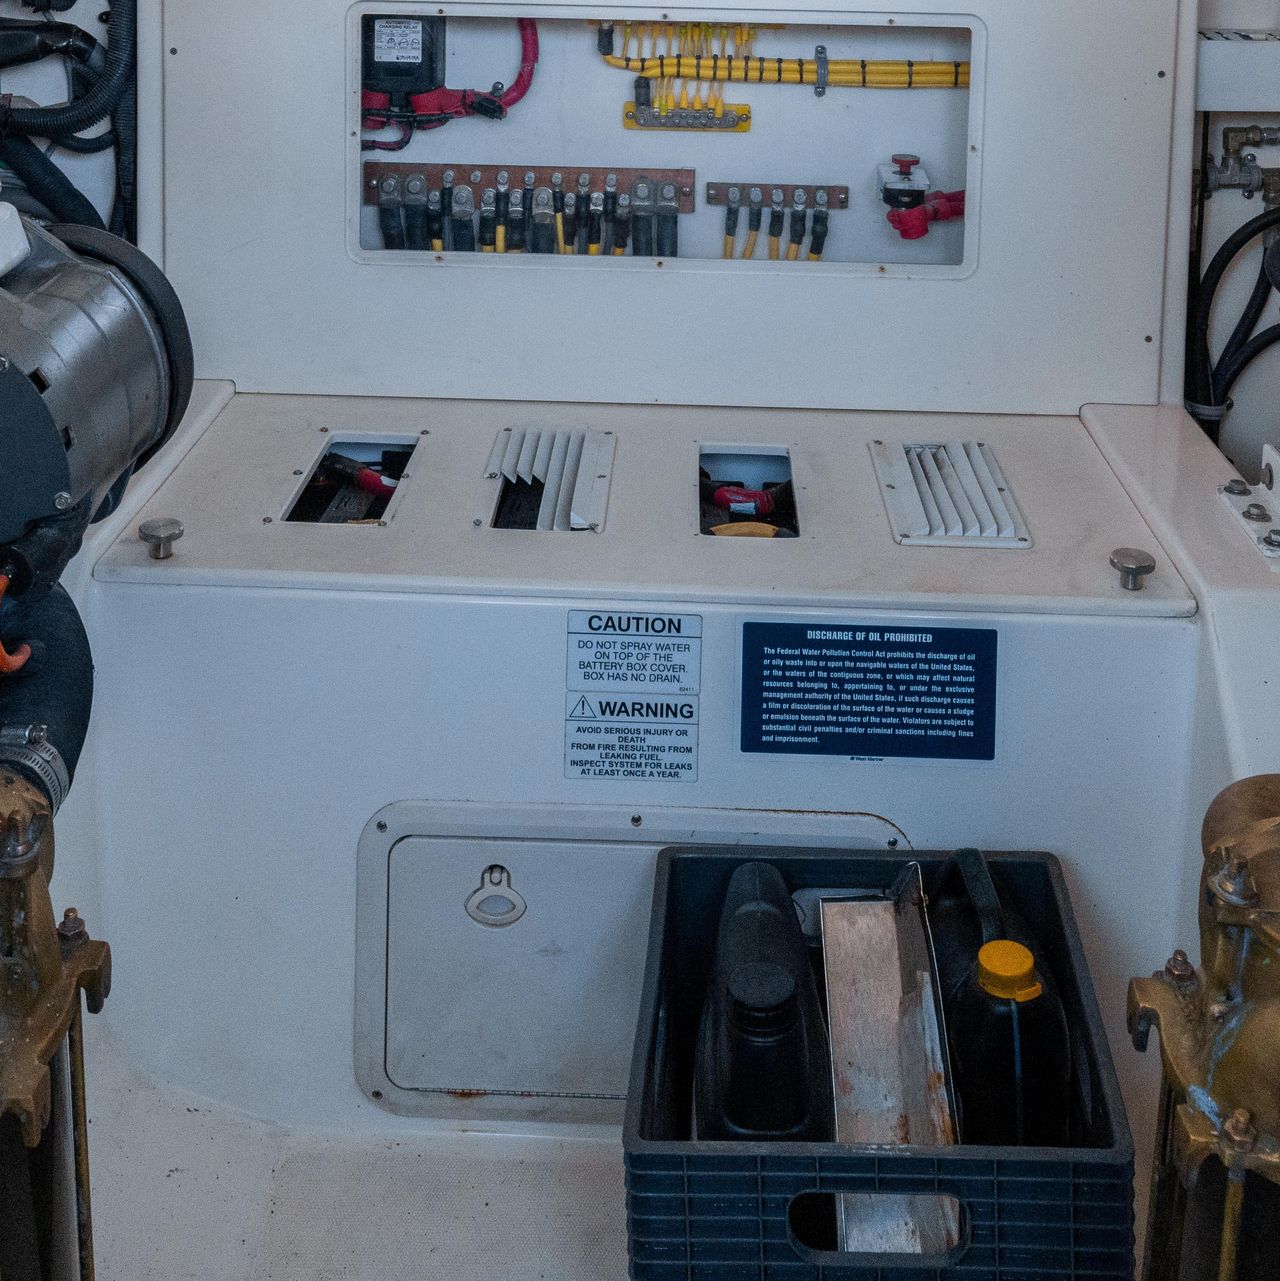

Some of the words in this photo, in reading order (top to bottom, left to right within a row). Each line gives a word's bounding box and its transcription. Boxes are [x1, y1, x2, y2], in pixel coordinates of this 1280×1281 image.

[587, 614, 681, 634] CAUTION
[806, 630, 852, 640] DISCHARGE
[855, 631, 866, 640] OF
[868, 631, 881, 641] OIL
[884, 632, 932, 642] PROHIBITED
[577, 639, 593, 649] DO
[596, 640, 617, 650] NOT
[620, 640, 652, 651] SPRAY
[655, 642, 690, 652] WATER
[594, 650, 610, 660] ON
[614, 651, 633, 660] TOP
[635, 652, 650, 661] OF
[654, 652, 673, 662] THE
[764, 646, 775, 654] The
[776, 647, 800, 655] Federal
[821, 648, 850, 656] Pollution
[851, 649, 874, 657] Control
[886, 651, 914, 659] prohibits
[927, 651, 957, 661] discharge
[578, 660, 624, 670] BATTERY
[626, 662, 648, 671] BOX
[650, 662, 688, 673] COVER.
[771, 658, 783, 666] oily
[856, 661, 886, 669] navigable
[930, 662, 951, 670] United
[952, 663, 975, 671] States,
[582, 670, 605, 680] BOX
[606, 671, 628, 681] HAS
[630, 672, 646, 682] NO
[648, 673, 683, 683] DRAIN.
[598, 700, 694, 718] WARNING
[576, 725, 602, 734] AVOID
[604, 726, 641, 735] SERIOUS
[642, 728, 673, 736] INJURY
[617, 735, 646, 743] DEATH
[570, 742, 596, 750] FROM
[597, 743, 616, 751] FIRE
[618, 743, 666, 753] RESULTING
[667, 745, 692, 753] FROM
[599, 751, 637, 760] LEAKING
[638, 753, 663, 761] FUEL.
[570, 759, 606, 767] INSPECT
[608, 760, 642, 768] SYSTEM
[644, 761, 662, 769] FOR
[664, 762, 692, 770] LEAKS
[593, 768, 620, 776] LEAST
[622, 769, 646, 777] ONCE
[656, 770, 681, 778] YEAR.
